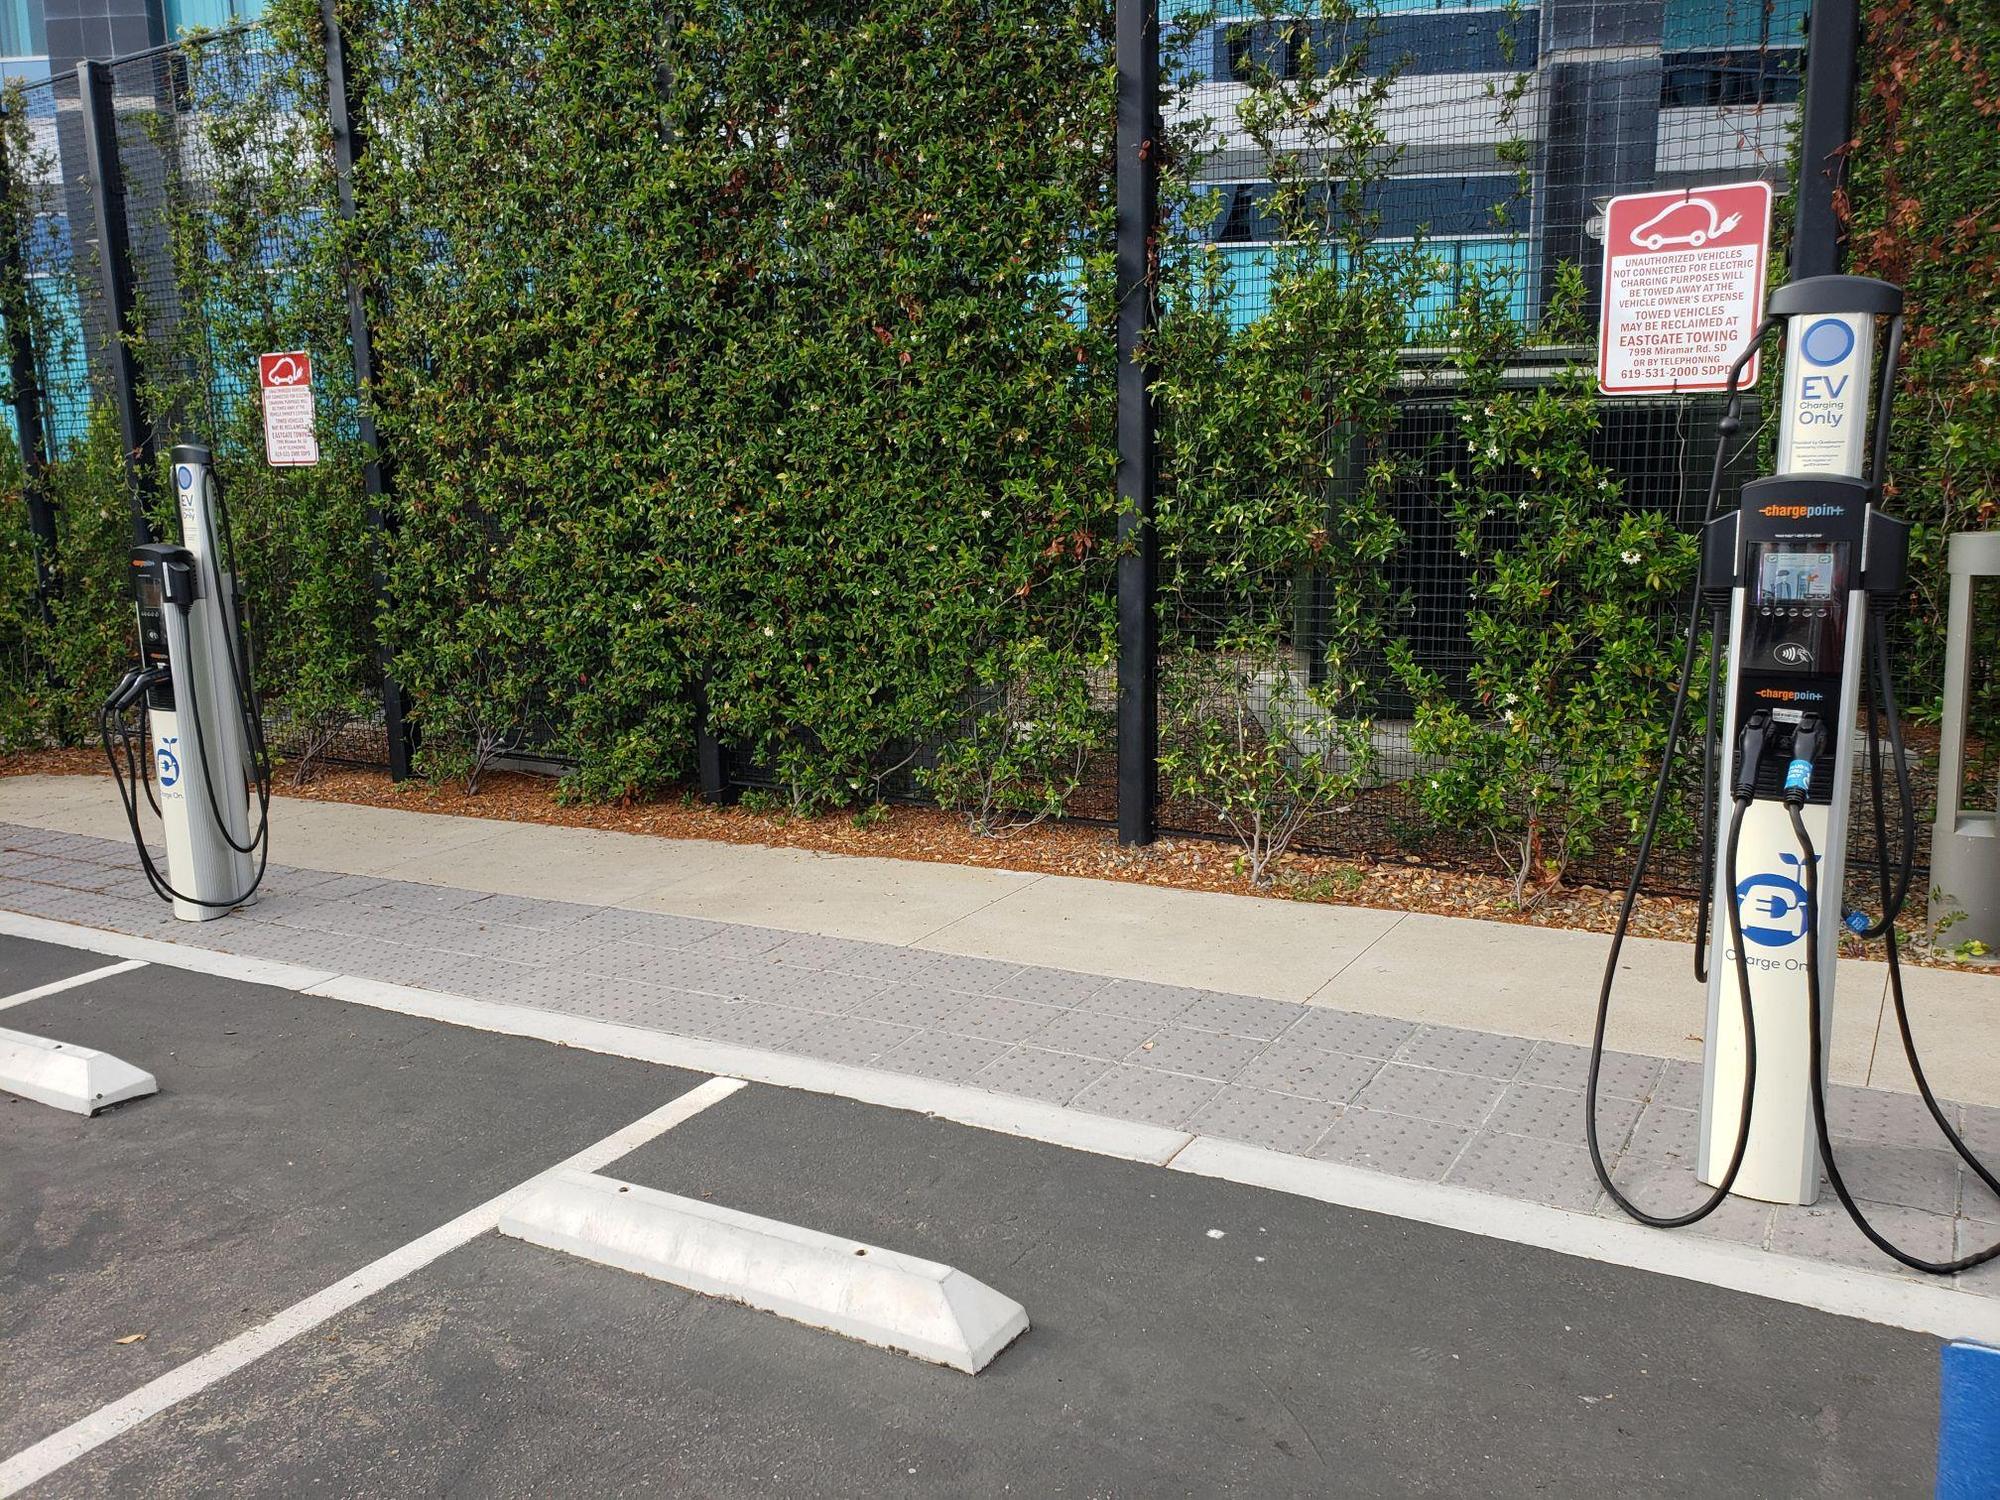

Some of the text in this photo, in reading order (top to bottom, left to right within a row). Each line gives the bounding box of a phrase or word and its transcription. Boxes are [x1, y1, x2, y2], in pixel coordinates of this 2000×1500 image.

[1625, 250, 1742, 267] UNAUTHORIZED VEHICLES
[1614, 259, 1753, 278] NOT CONNECTED FOR ELECTRIC
[1621, 271, 1744, 288] CHARGING PURPOSES WILL
[1629, 282, 1734, 297] BE TOWED AWAY AT THE
[1619, 291, 1744, 308] VEHICLE OWNER'S EXPENSE
[1635, 305, 1725, 320] TOWED VEHICLES
[1621, 316, 1739, 332] MAY BE RECLAIMED AT
[1620, 330, 1738, 347] EASTGATE TOWING
[1629, 343, 1727, 356] 7998 Miramar Rd. SD
[1633, 355, 1720, 367] OR BY TELEPHONING
[1621, 365, 1732, 379] 619-531-2000 SDPD
[1801, 374, 1849, 400] EV
[1800, 401, 1844, 410] Charging
[1800, 411, 1843, 427] Only
[181, 494, 193, 507] EV
[1725, 948, 1781, 971] Carge
